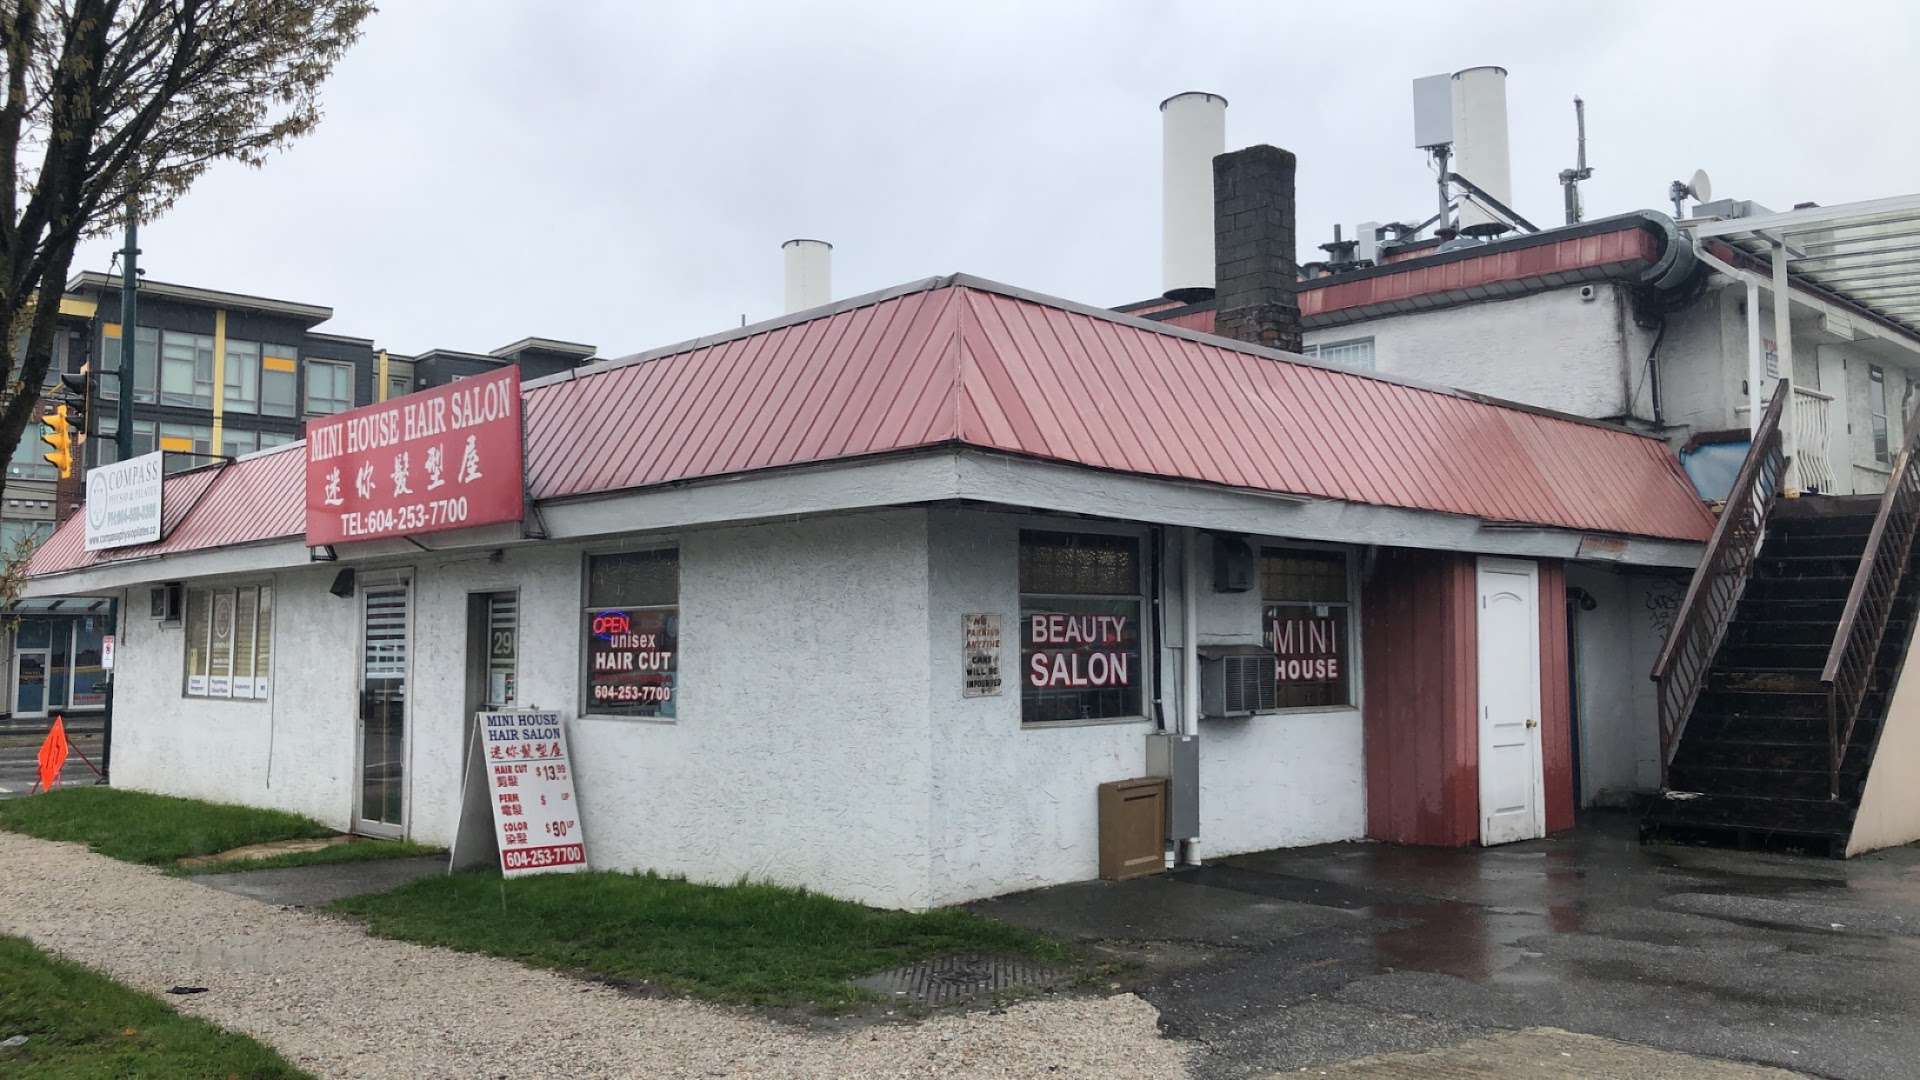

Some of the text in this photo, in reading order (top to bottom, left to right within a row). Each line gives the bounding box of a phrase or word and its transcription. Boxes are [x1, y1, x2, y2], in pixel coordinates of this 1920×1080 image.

[310, 377, 512, 462] MINI HOUSE HAIR SALON
[108, 460, 158, 490] COMPASS
[324, 433, 483, 506] 迷你髮型屋
[340, 496, 468, 537] TEL:604-253-7700
[592, 617, 631, 635] OPEN
[1031, 615, 1126, 643] BEAUTY
[494, 630, 515, 655] 29
[611, 630, 656, 649] unisex
[1273, 619, 1337, 655] MINI
[595, 651, 672, 671] HAIR CUT
[1030, 652, 1129, 688] SALON
[1275, 658, 1338, 680] HOUSE
[966, 668, 987, 677] WILL
[594, 685, 671, 701] 604-253-7700
[487, 713, 559, 727] MINI HOUSE
[488, 728, 561, 741] HAIR SALON
[494, 764, 528, 775] HAIR CUT
[499, 793, 520, 803] PERM
[503, 821, 528, 833] COLOR
[506, 848, 581, 867] 604-253-7700
